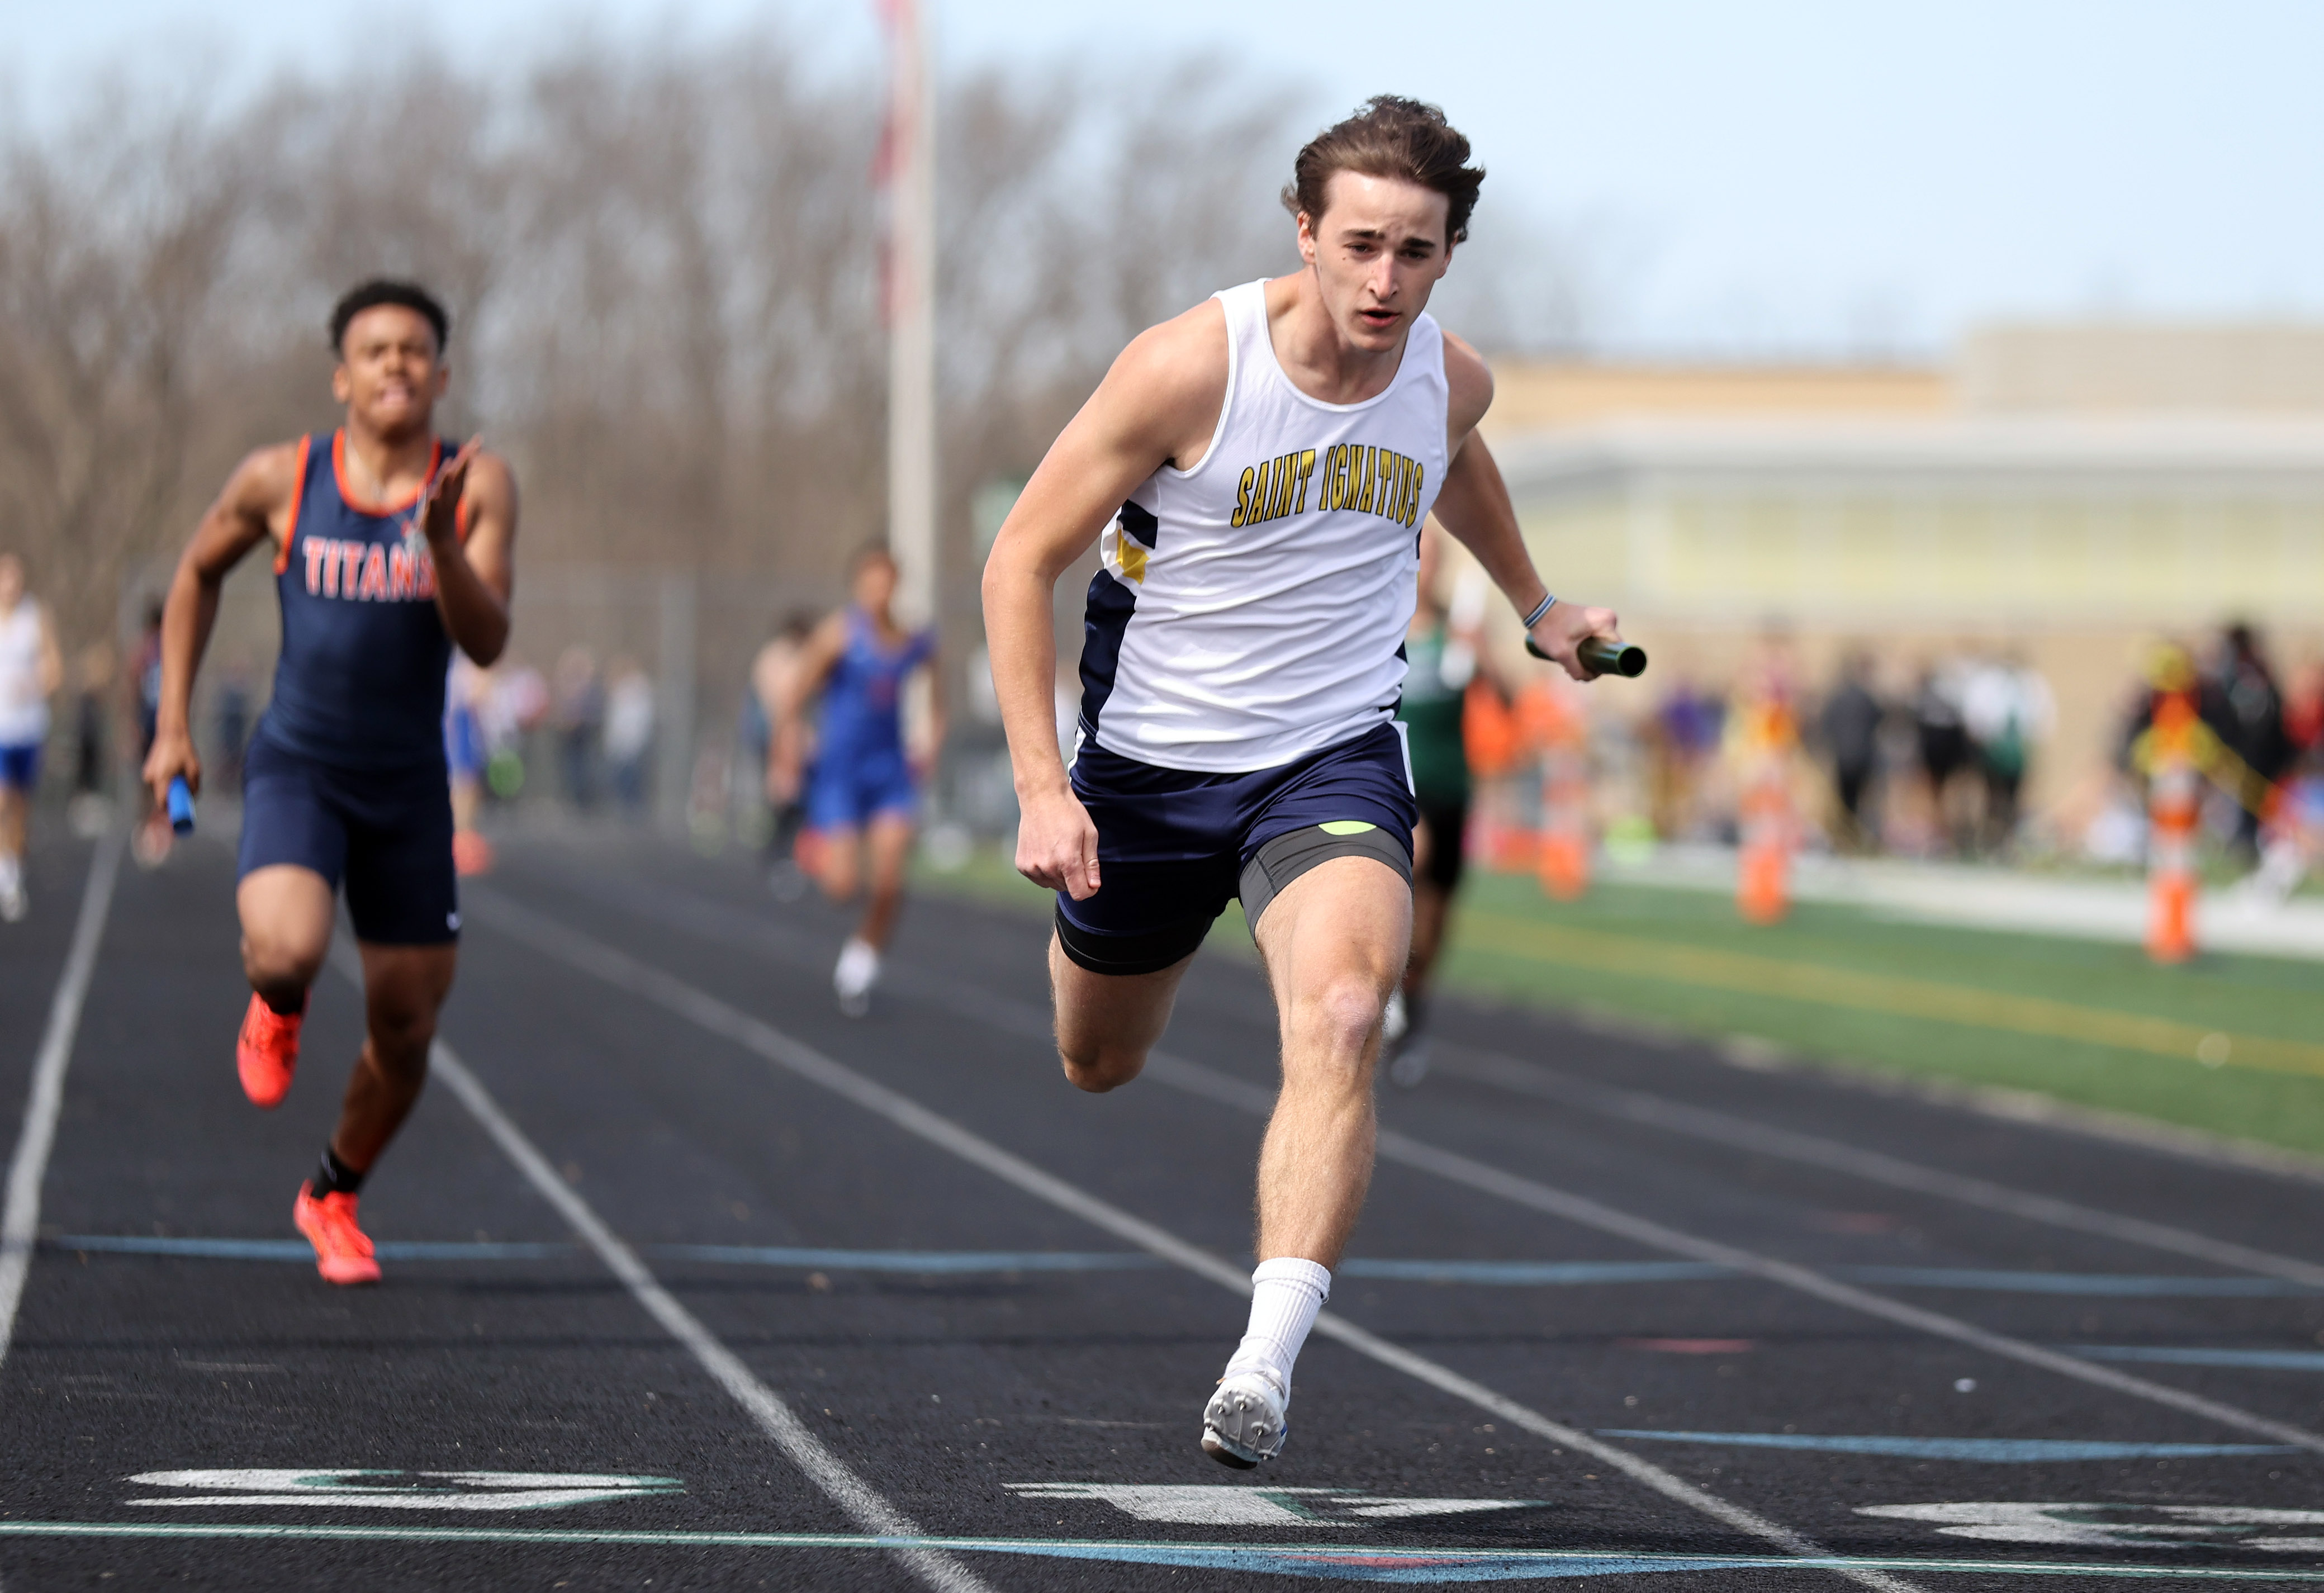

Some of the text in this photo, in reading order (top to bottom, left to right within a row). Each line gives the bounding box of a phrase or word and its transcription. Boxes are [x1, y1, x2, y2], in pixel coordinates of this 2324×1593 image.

[1230, 443, 1424, 529] SAINT IGNATIUS
[302, 534, 438, 603] TITANS
